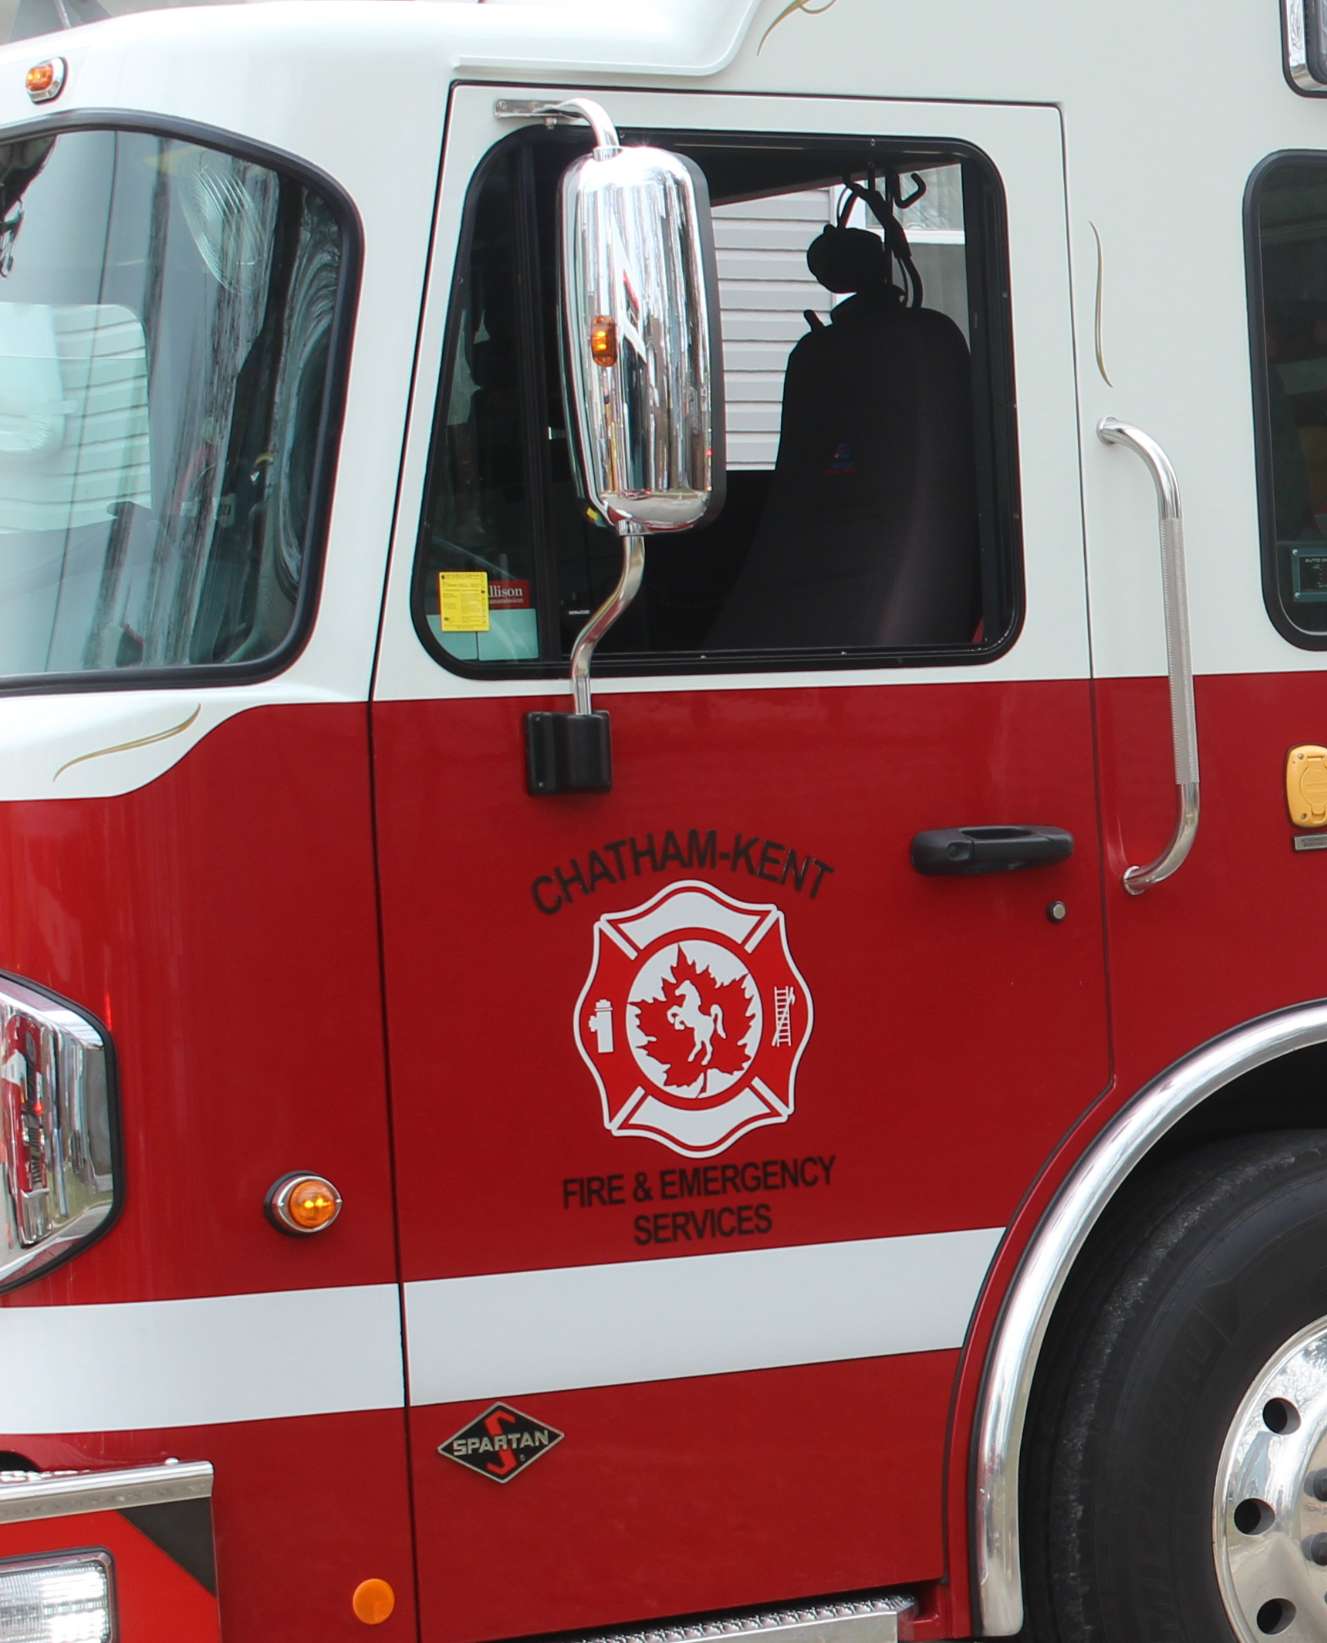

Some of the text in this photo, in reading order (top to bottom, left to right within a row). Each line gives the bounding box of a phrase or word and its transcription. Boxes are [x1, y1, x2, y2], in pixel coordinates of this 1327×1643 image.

[488, 585, 523, 598] llison
[532, 829, 835, 916] CHATHAM-KENT
[562, 1155, 837, 1209] FIRE & EMERGENCY
[633, 1203, 773, 1245] SERVICES
[453, 1430, 549, 1455] SPARTAN
